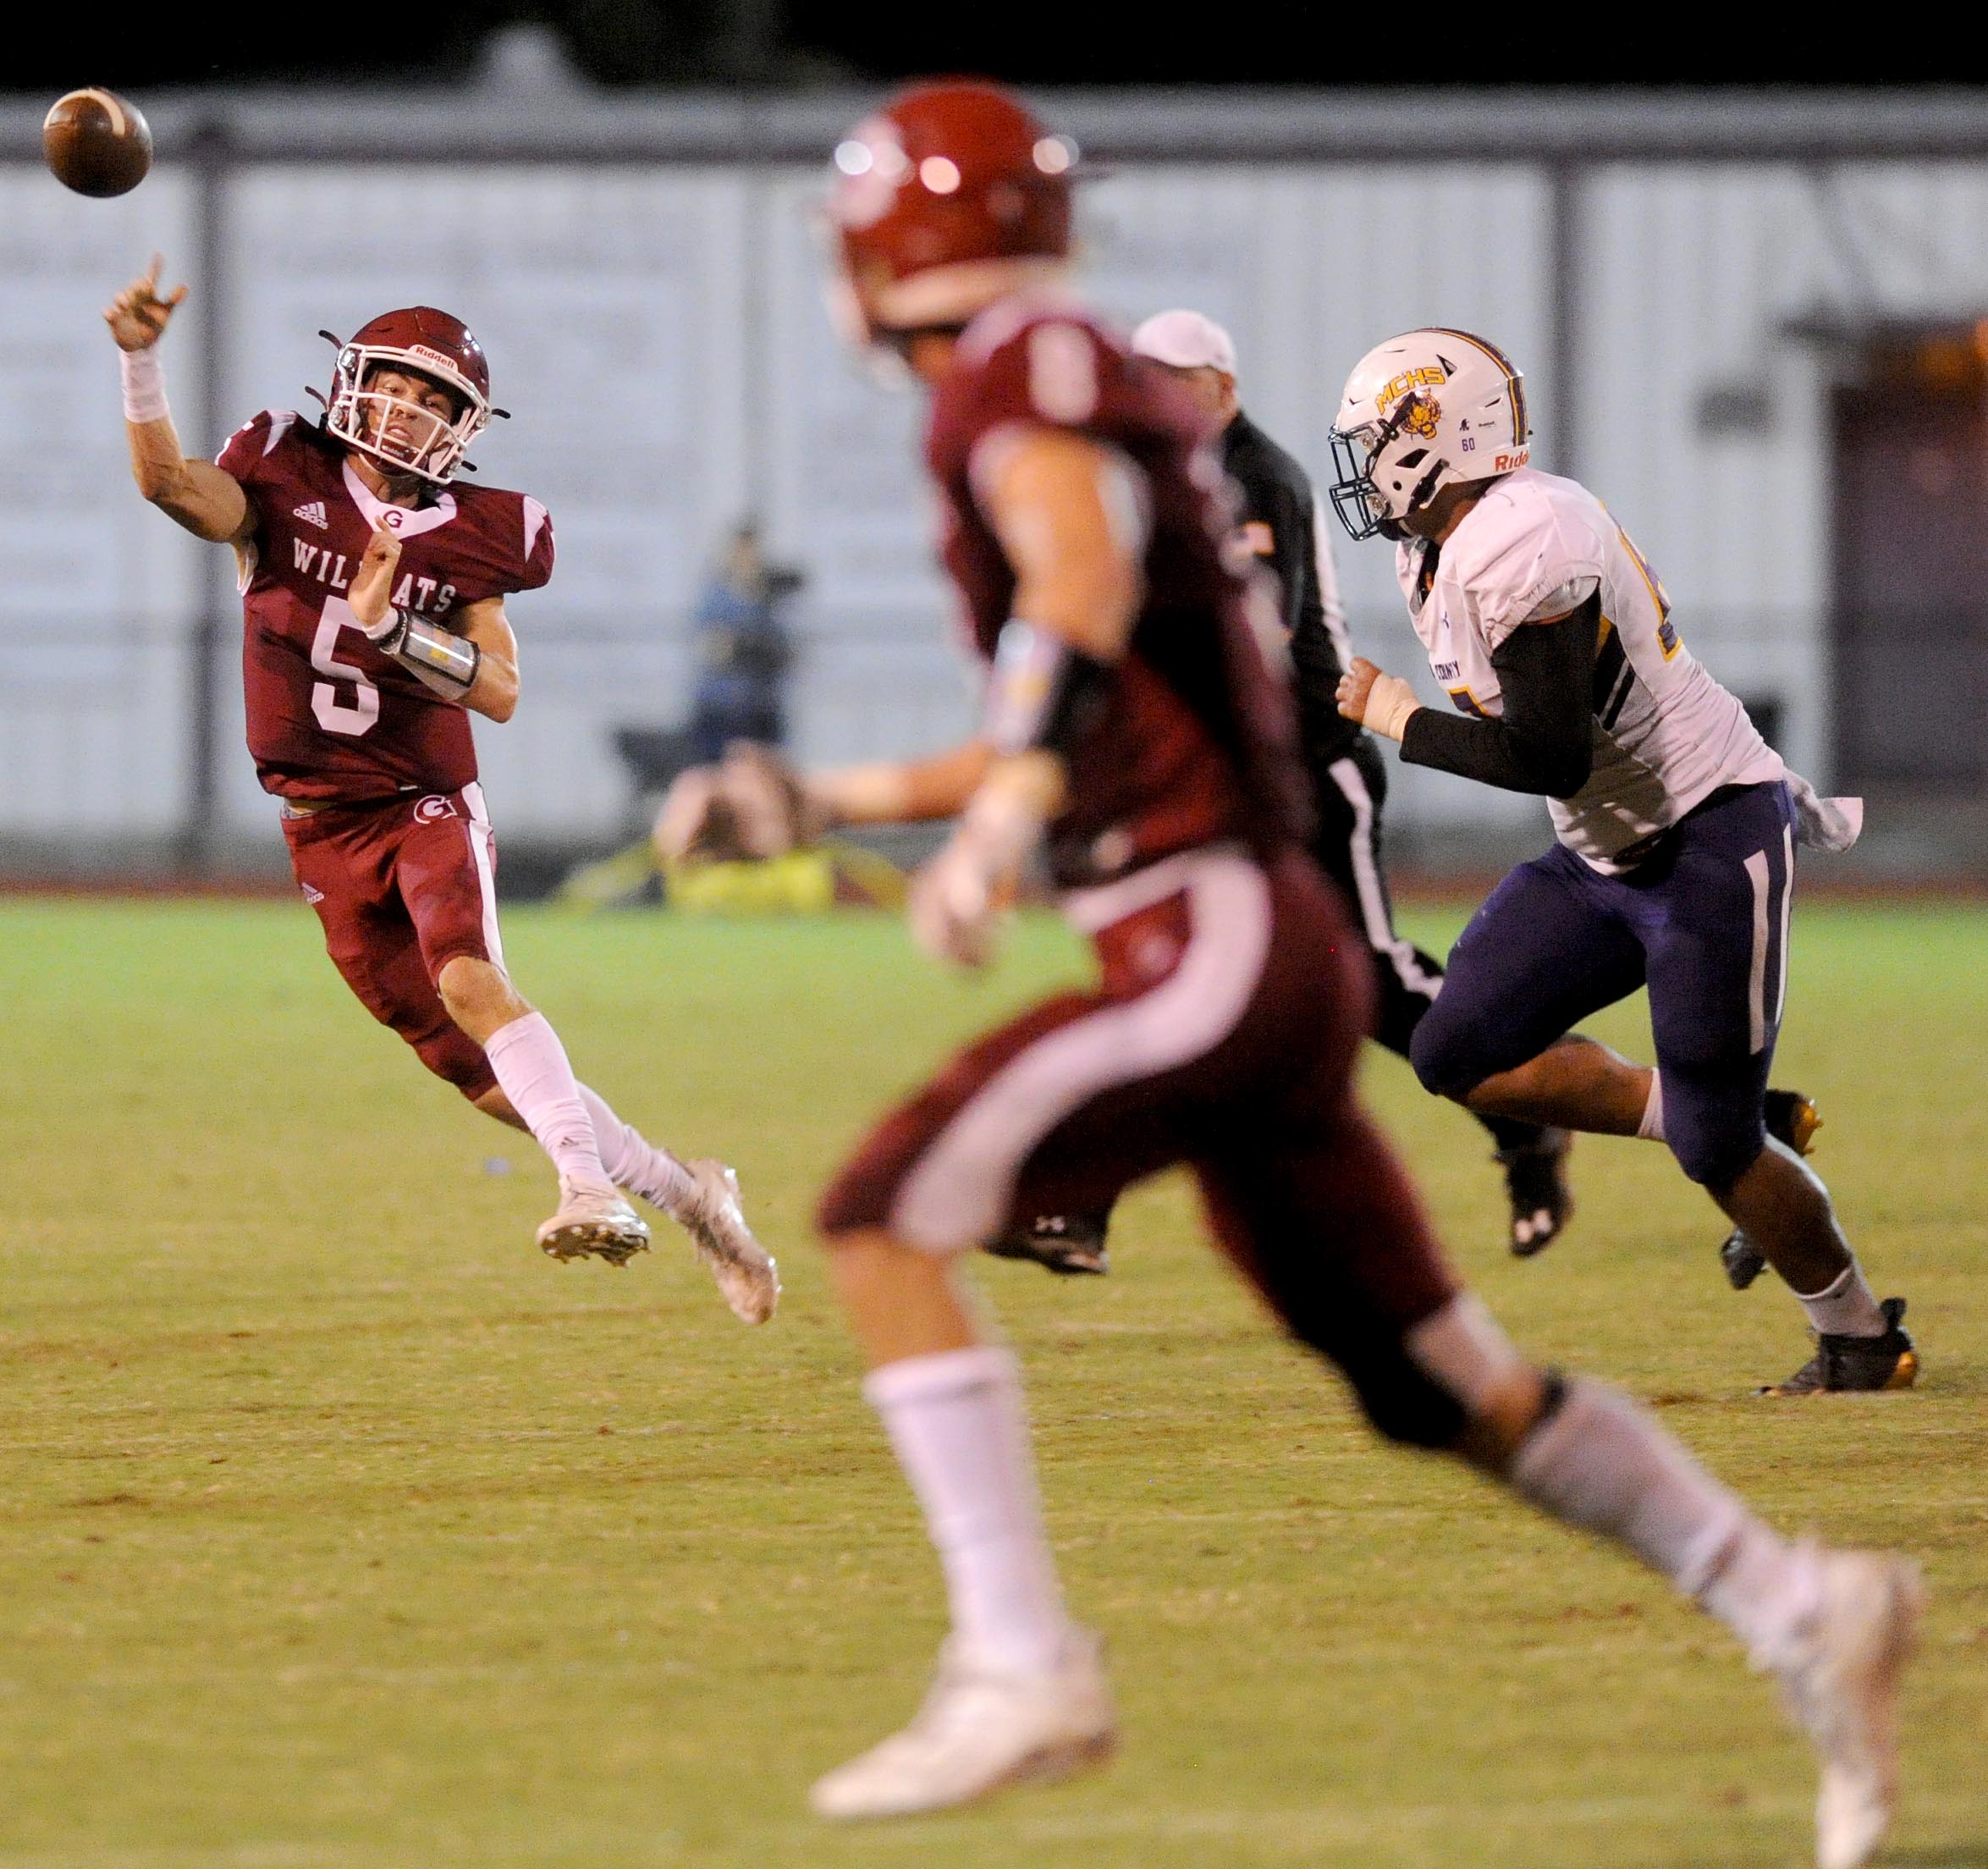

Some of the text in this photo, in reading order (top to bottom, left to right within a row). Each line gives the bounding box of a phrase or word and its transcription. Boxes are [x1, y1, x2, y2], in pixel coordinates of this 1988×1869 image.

[416, 347, 454, 368] Riddell
[1375, 367, 1446, 416] MCHS
[1462, 438, 1475, 451] 60
[383, 510, 404, 529] G
[294, 537, 456, 612] WILATS
[311, 594, 379, 736] 5
